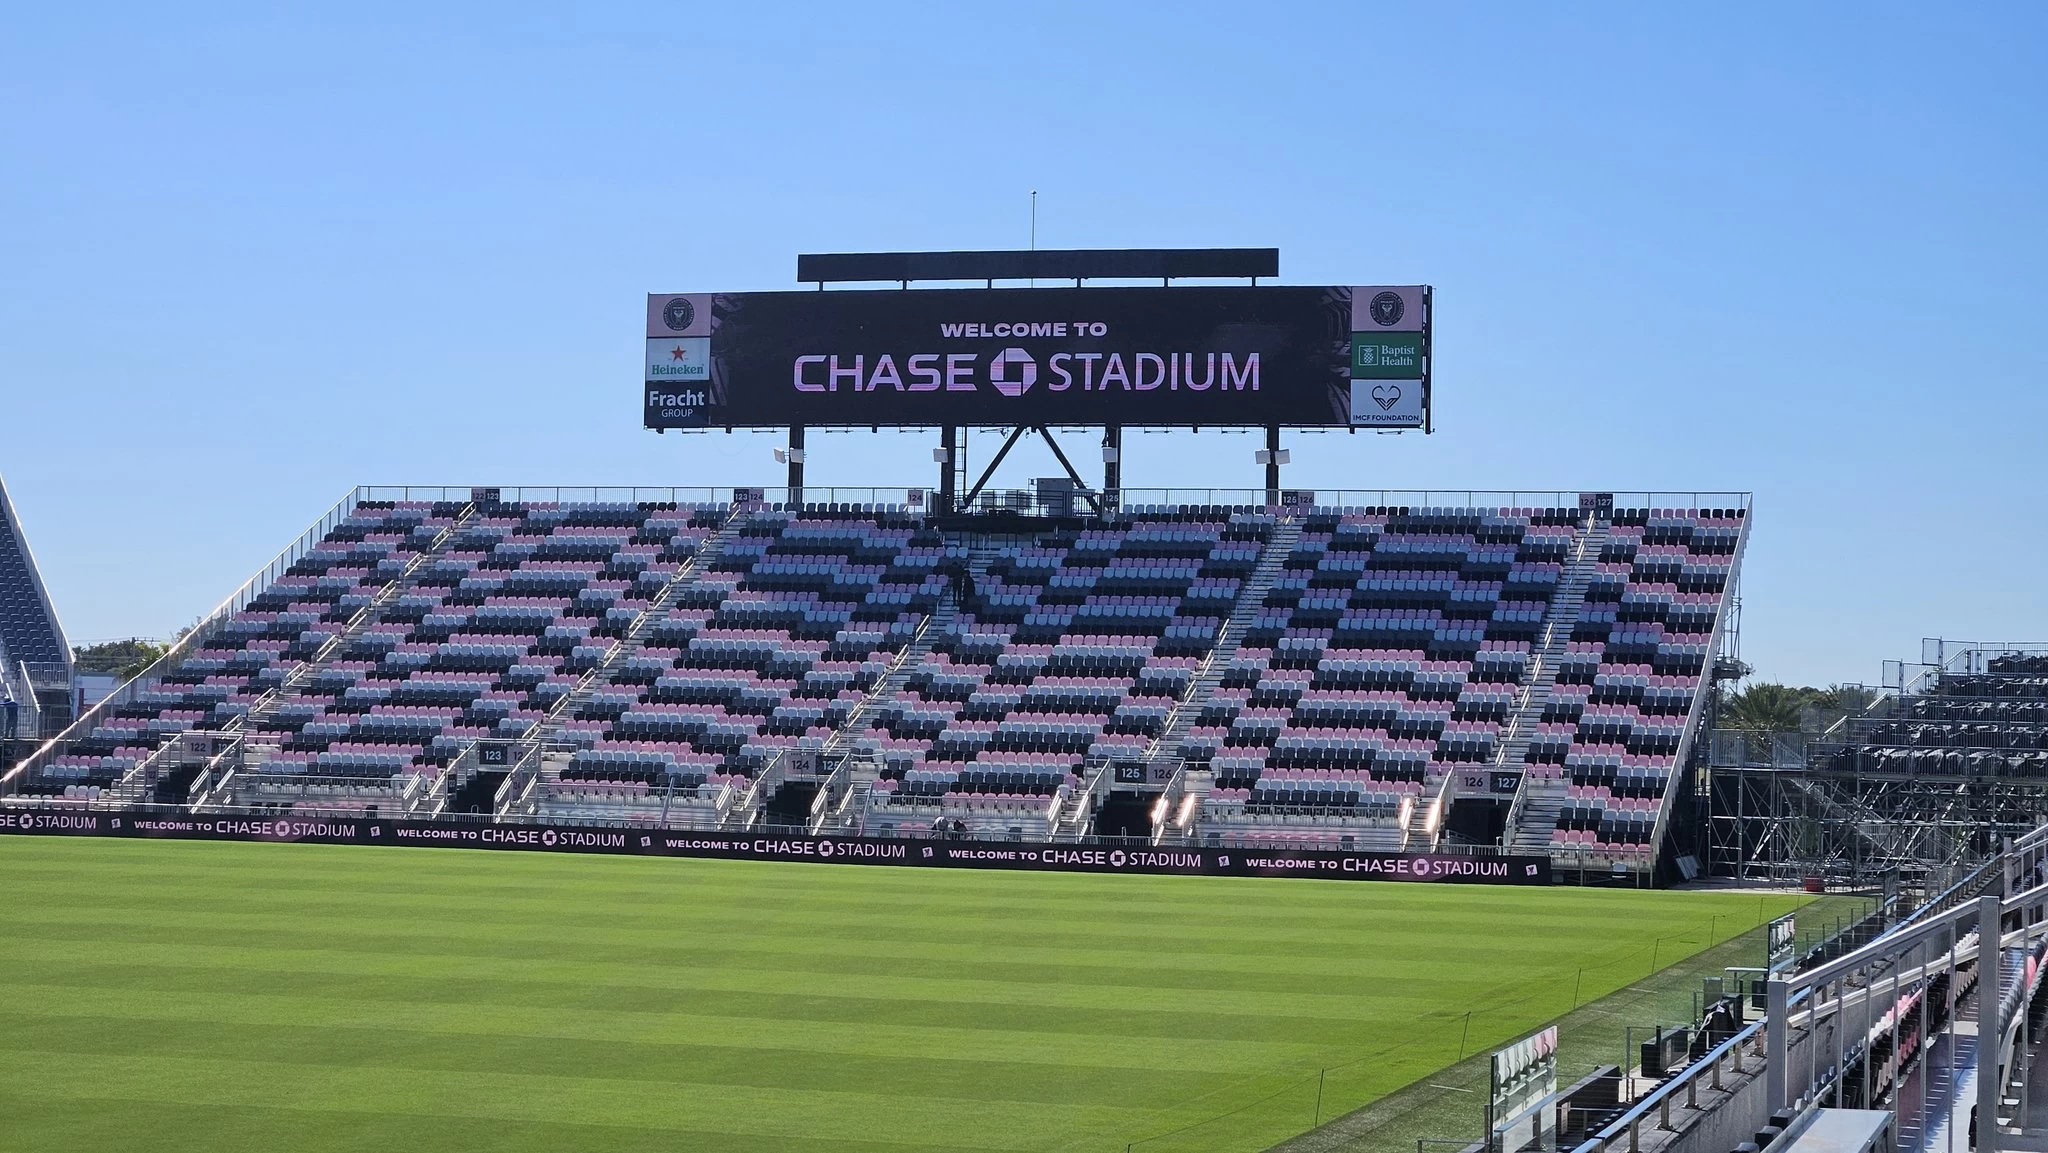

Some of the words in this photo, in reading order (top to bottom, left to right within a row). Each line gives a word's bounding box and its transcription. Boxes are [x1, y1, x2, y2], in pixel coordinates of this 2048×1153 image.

[940, 323, 1067, 338] WELCOME
[1073, 322, 1108, 337] TO
[1381, 345, 1415, 356] Baptist
[1381, 356, 1413, 366] Health
[651, 364, 704, 375] Heineken
[793, 353, 978, 392] CHASE
[1048, 352, 1260, 391] STADIUM
[649, 389, 705, 407] Fracht
[661, 408, 694, 418] GROUP
[486, 492, 499, 500] 123
[735, 493, 748, 501] 123
[1105, 494, 1119, 502] 125
[190, 743, 206, 752] 122
[485, 750, 501, 760] 123
[792, 760, 809, 770] 124
[1121, 768, 1140, 778] 125
[1154, 769, 1172, 779] 126
[1464, 777, 1484, 787] 126
[1498, 778, 1517, 788] 127
[36, 815, 97, 829] STADIUM
[134, 821, 193, 831] WELCOME
[197, 822, 212, 831] TO
[216, 820, 273, 835] CHASE
[292, 822, 356, 837] STADIUM
[397, 829, 458, 839] WELCOME
[461, 831, 477, 840] TO
[481, 829, 538, 844] CHASE
[559, 832, 625, 847] STADIUM
[666, 839, 729, 850] WELCOME
[732, 842, 750, 850] TO
[754, 840, 814, 855] CHASE
[837, 843, 905, 858] STADIUM
[949, 849, 1016, 860] WELCOME
[1019, 851, 1037, 861] TO
[1042, 849, 1106, 865] CHASE
[1129, 852, 1201, 868] STADIUM
[1246, 858, 1316, 869] WELCOME
[1319, 860, 1338, 869] TO
[1343, 858, 1409, 874] CHASE
[1432, 860, 1508, 877] STADIUM
